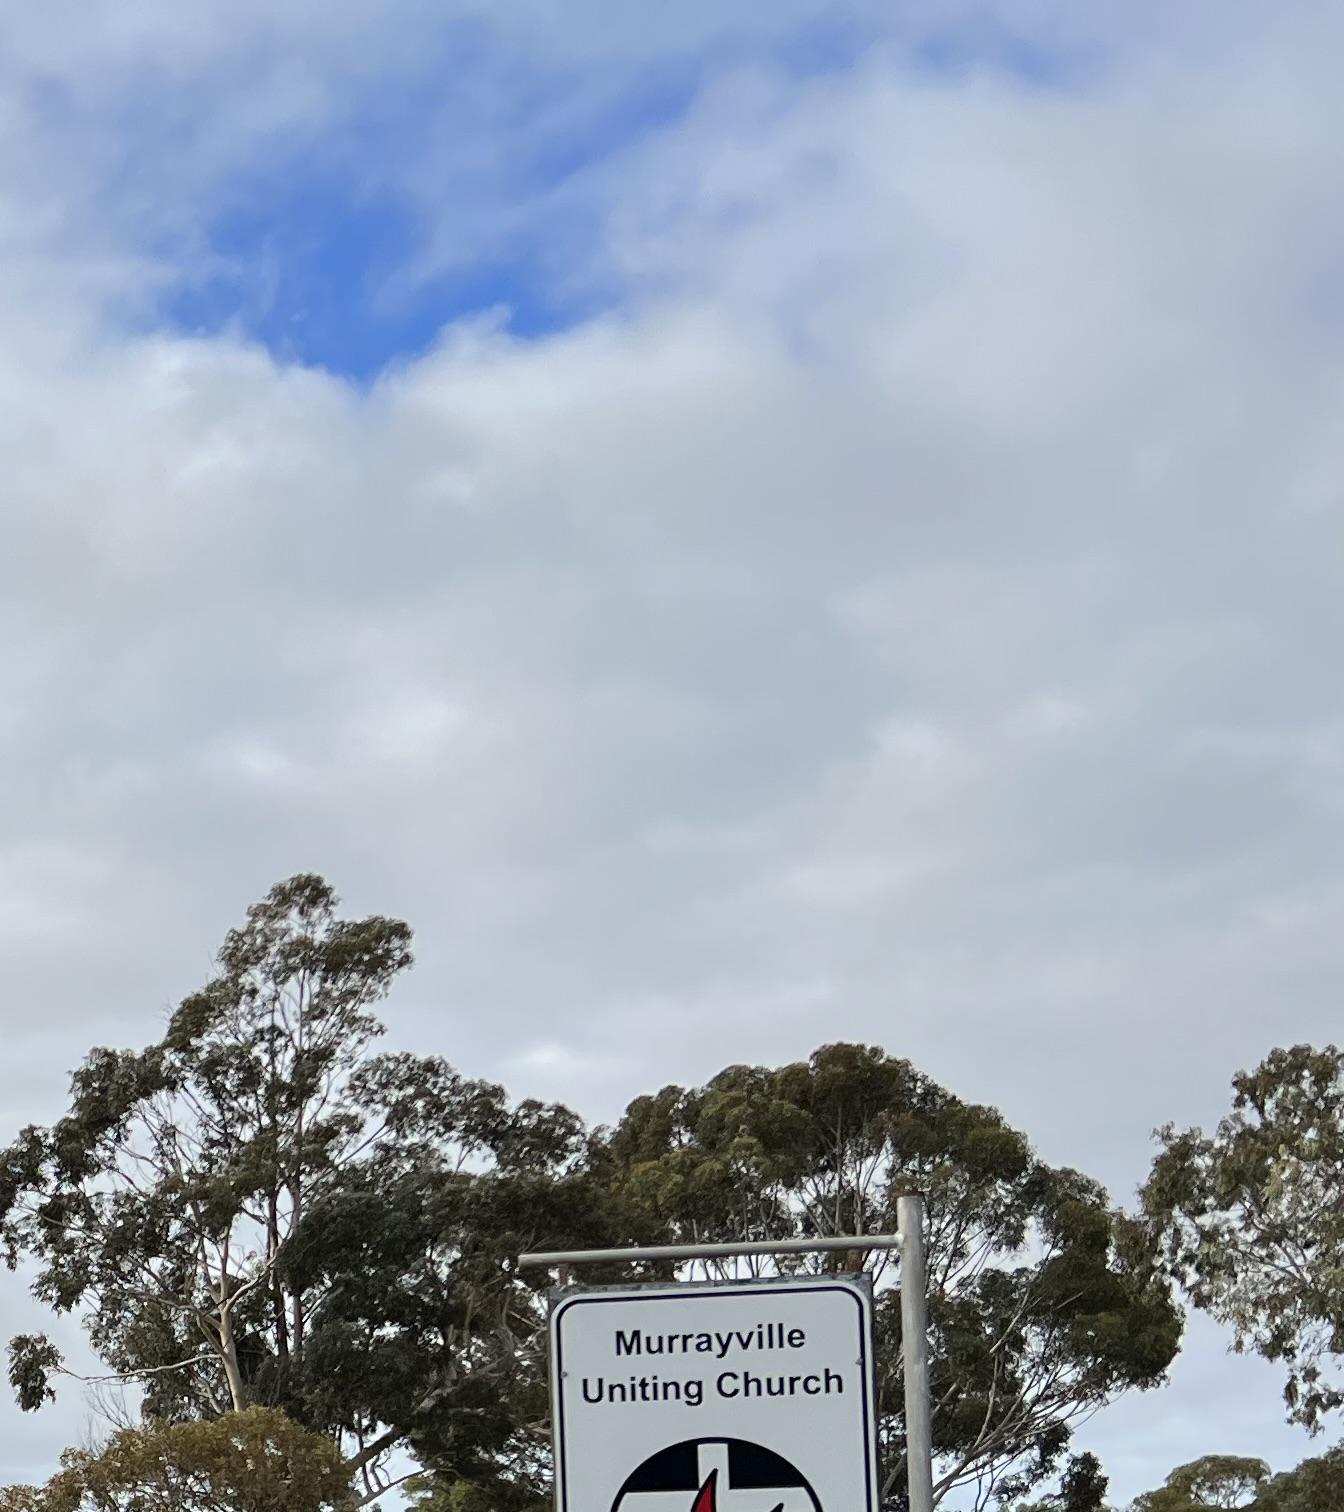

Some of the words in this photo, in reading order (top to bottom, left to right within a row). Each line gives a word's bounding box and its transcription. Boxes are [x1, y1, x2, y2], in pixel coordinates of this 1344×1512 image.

[615, 1323, 806, 1359] Murrayville
[582, 1375, 704, 1407] Uniting
[716, 1368, 844, 1399] Church
